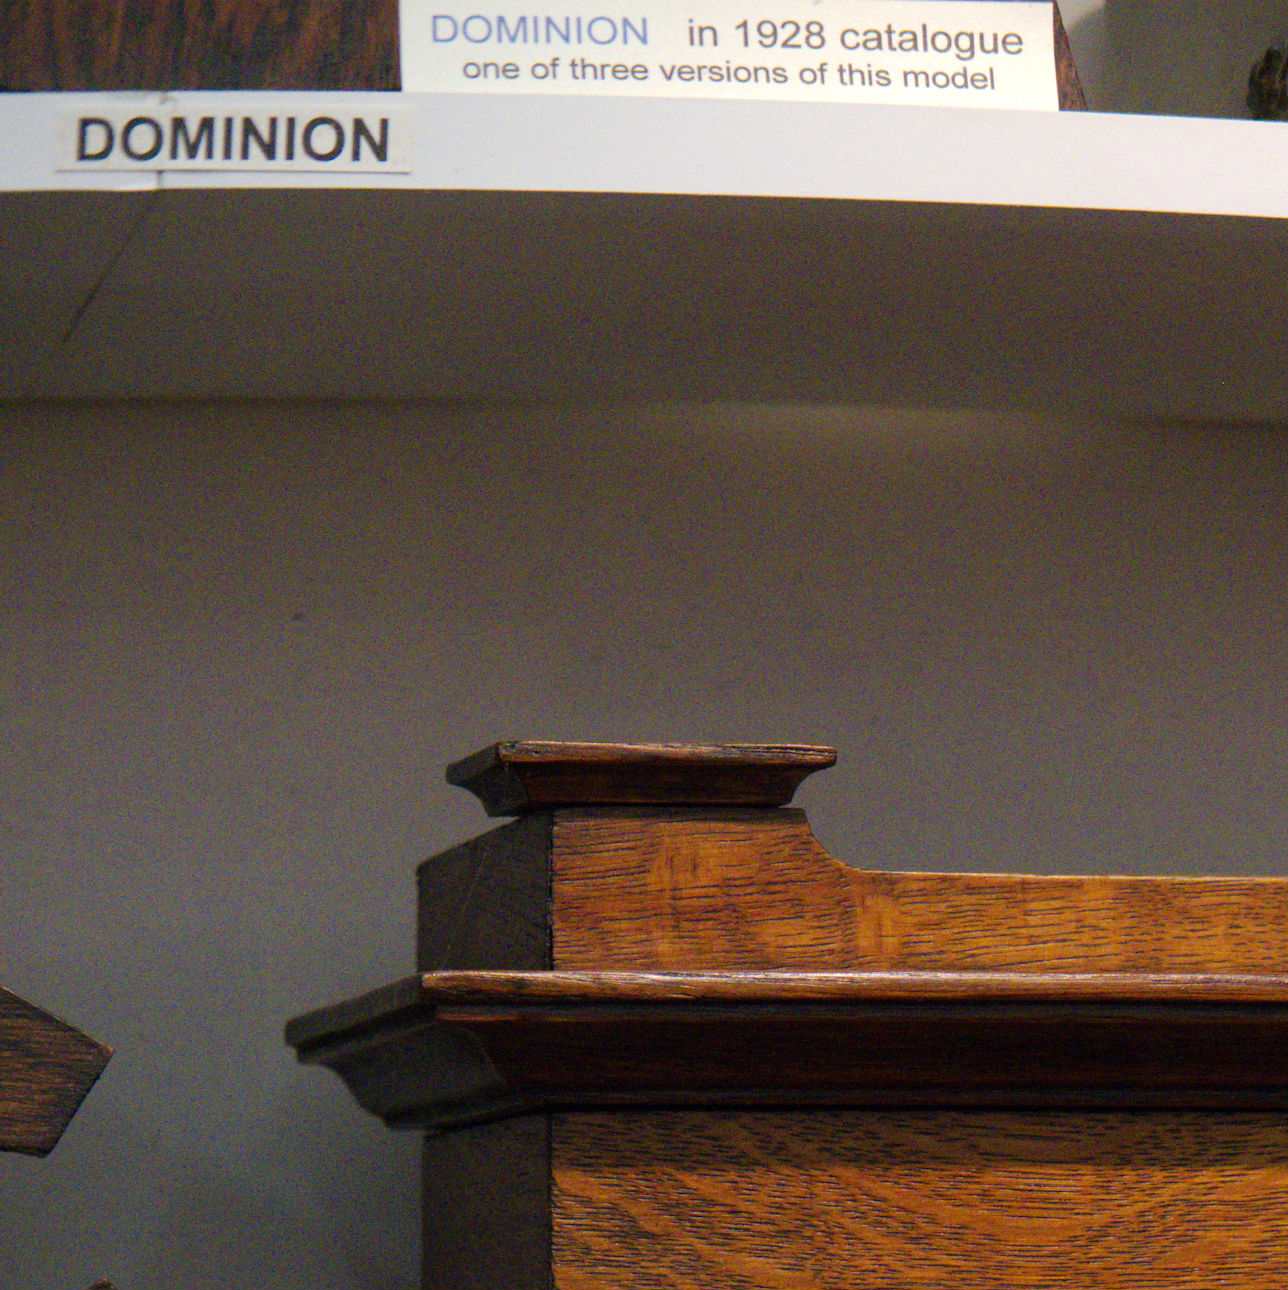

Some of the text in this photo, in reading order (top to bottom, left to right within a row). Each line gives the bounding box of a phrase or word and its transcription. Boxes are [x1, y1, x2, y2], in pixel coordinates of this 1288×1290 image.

[431, 14, 1024, 62] DOMINION in 1928 catalogue
[462, 56, 996, 91] one of three versions of this model
[74, 114, 393, 164] DOMINION
